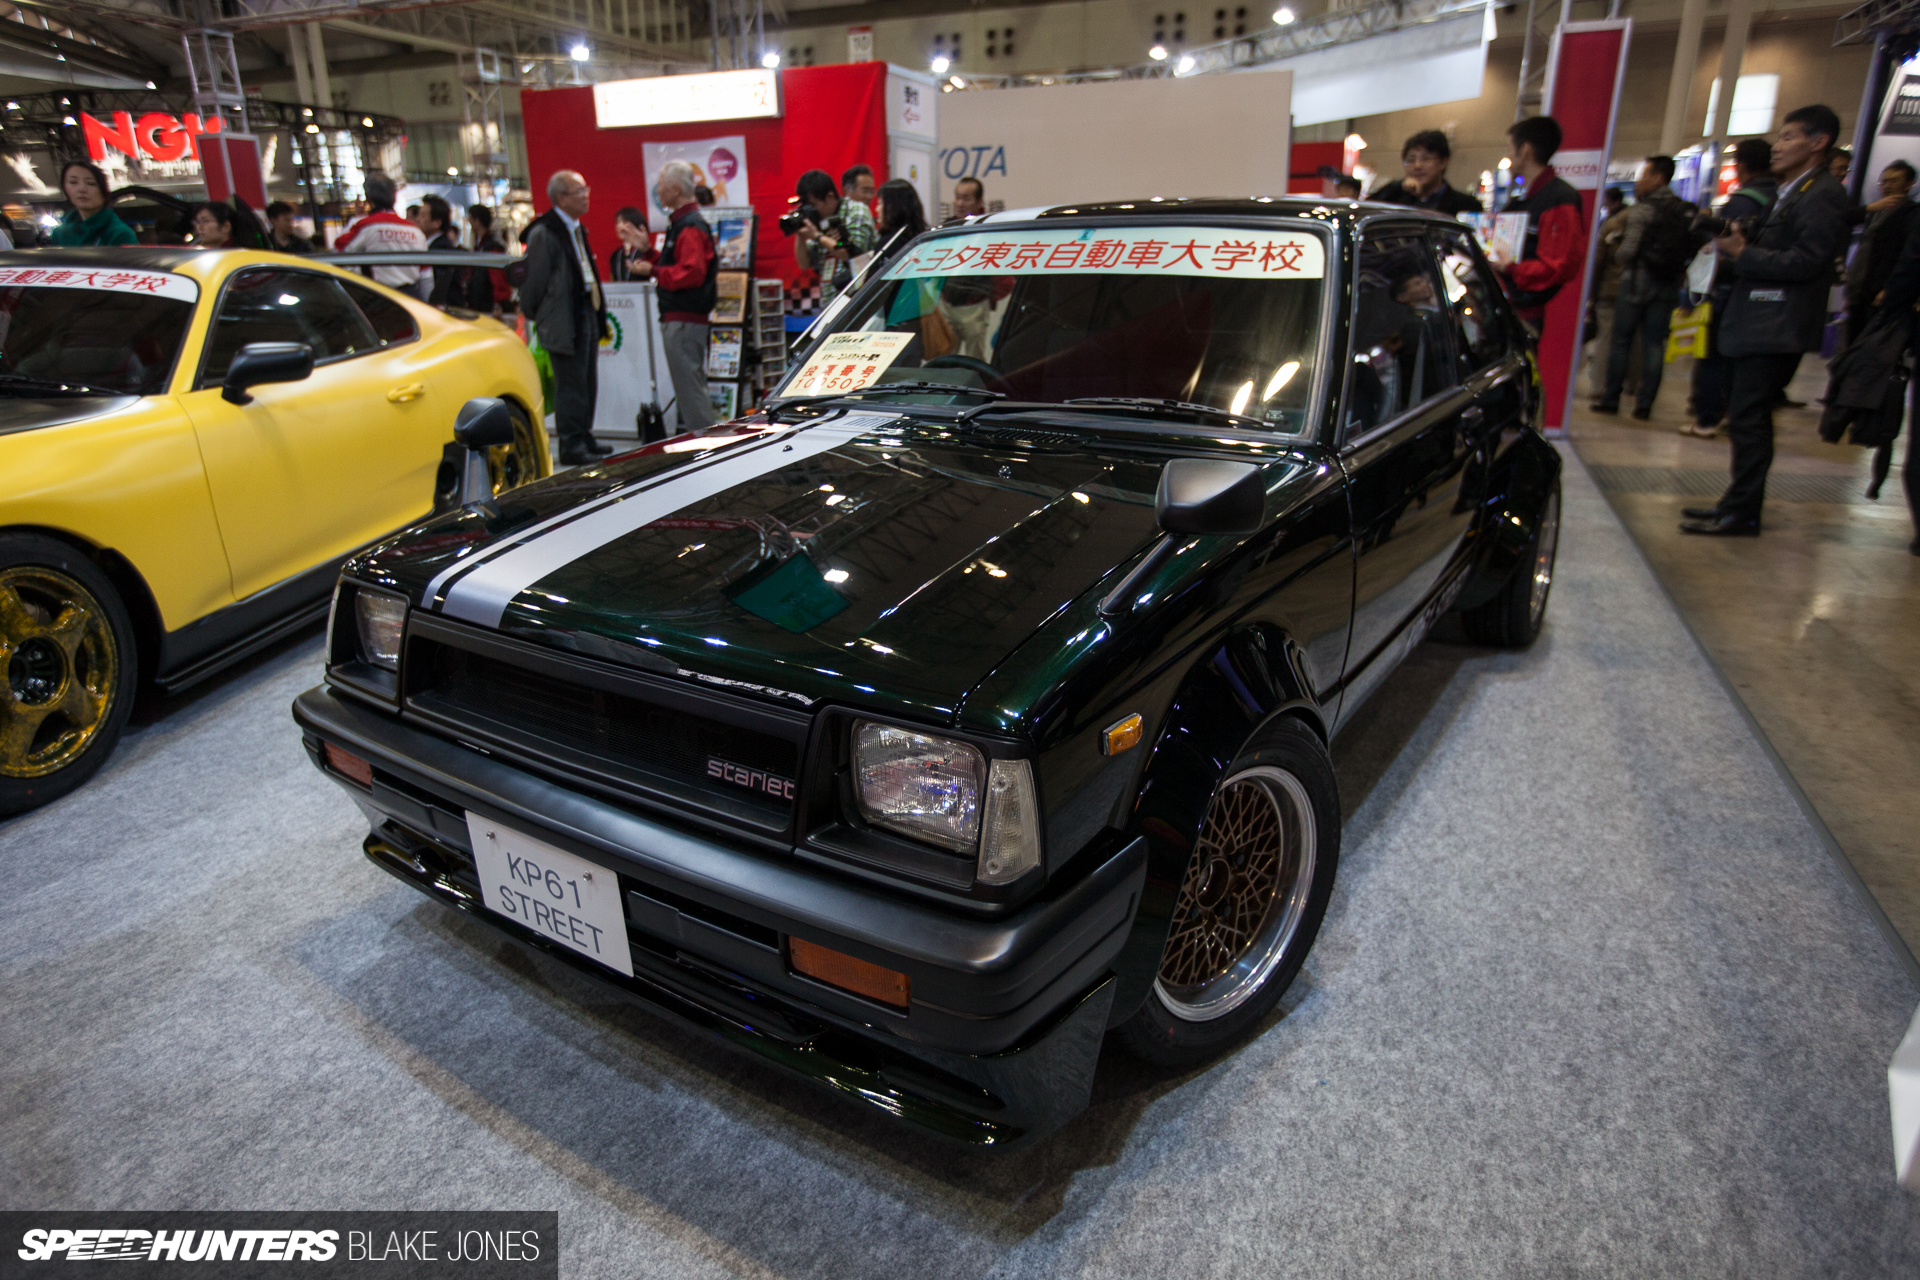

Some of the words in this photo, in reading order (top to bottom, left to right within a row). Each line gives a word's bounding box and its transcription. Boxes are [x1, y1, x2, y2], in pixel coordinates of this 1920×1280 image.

[895, 239, 1304, 275] トヨタ東京自動車大学校
[507, 852, 581, 909] KP61
[499, 885, 603, 954] STREET
